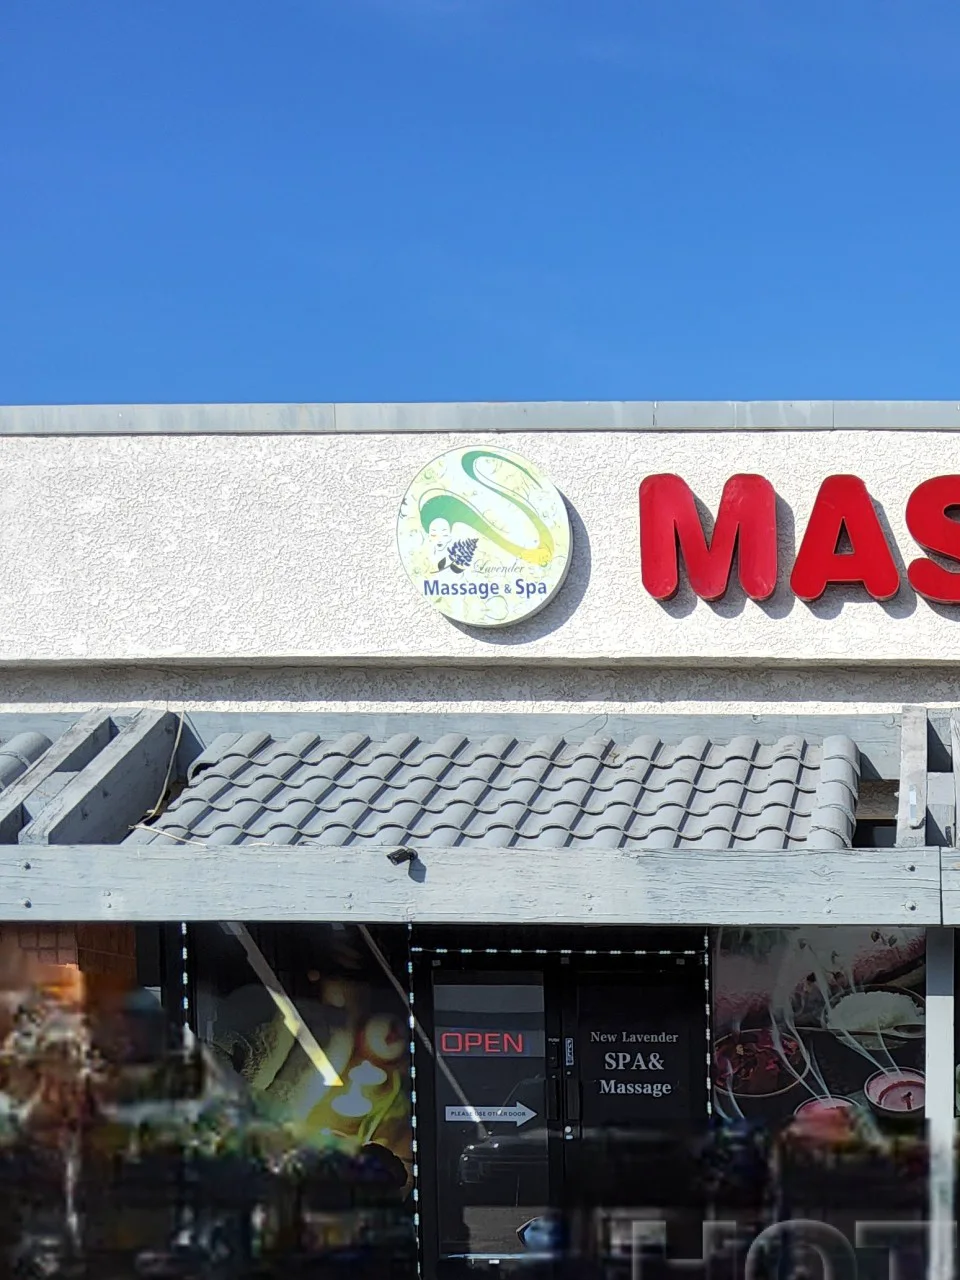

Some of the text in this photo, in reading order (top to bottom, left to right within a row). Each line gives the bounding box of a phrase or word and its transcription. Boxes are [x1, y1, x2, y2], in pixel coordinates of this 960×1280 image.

[472, 558, 524, 574] Lavender
[423, 578, 547, 599] Massage & Spa
[440, 1032, 524, 1053] OPEN
[590, 1031, 679, 1043] New Lavender
[600, 1079, 672, 1098] Massage
